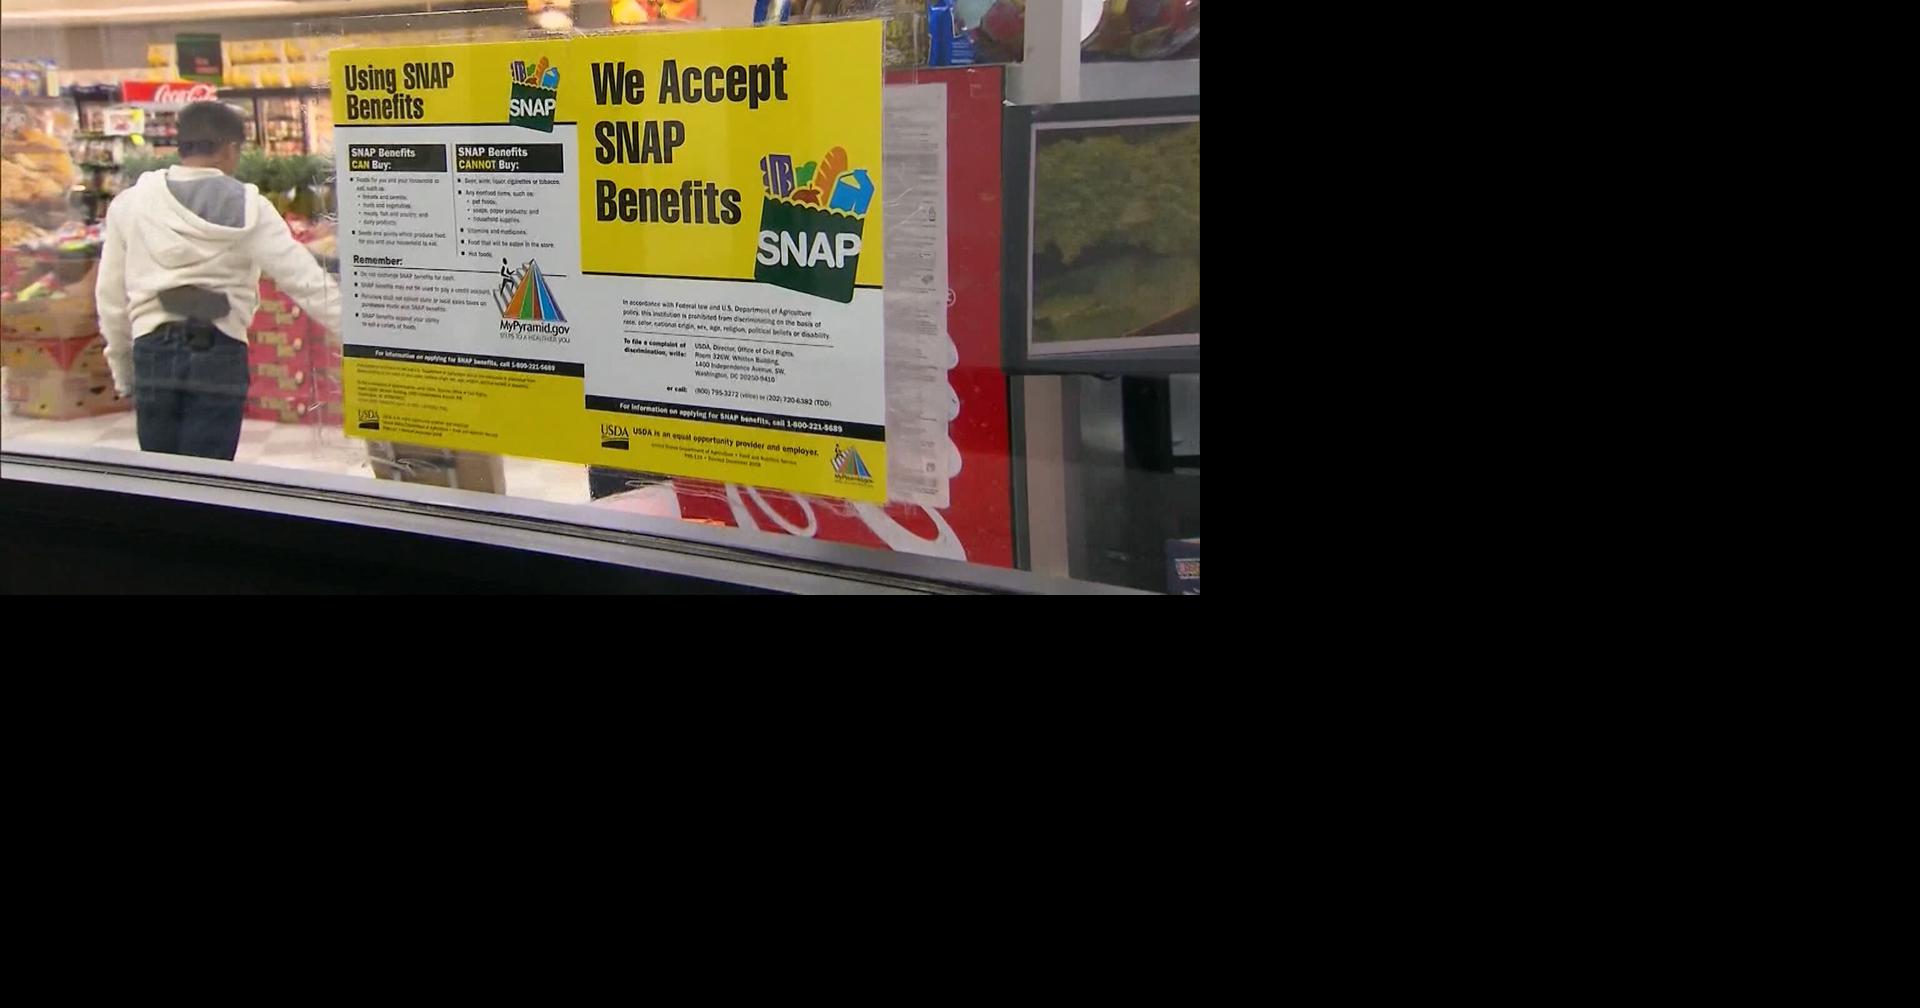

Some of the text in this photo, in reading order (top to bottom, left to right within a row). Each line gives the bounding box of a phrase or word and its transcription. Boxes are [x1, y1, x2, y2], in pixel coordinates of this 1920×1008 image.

[345, 62, 454, 94] Using SNAP
[591, 57, 788, 109] We Accept
[347, 94, 424, 120] Benefits
[510, 99, 557, 117] SNAP
[352, 148, 415, 157] SNAP Benefits
[458, 147, 528, 156] SNAP Benefits
[595, 121, 685, 164] SNAP
[351, 160, 392, 172] CAN Buy:
[459, 160, 519, 171] CANNOT Buy:
[596, 180, 741, 224] Benefits
[354, 255, 402, 265] Remember:
[756, 230, 861, 268] SNAP
[500, 320, 570, 336] MyPyramid.gov
[632, 404, 668, 413] information
[680, 410, 706, 419] applying
[741, 416, 770, 425] benefits,
[787, 420, 842, 432] 1-800-221-5689
[601, 424, 629, 437] USDA
[633, 428, 652, 436] USDA
[694, 436, 733, 446] opportunity
[736, 441, 764, 449] provider
[782, 446, 818, 456] employer.
